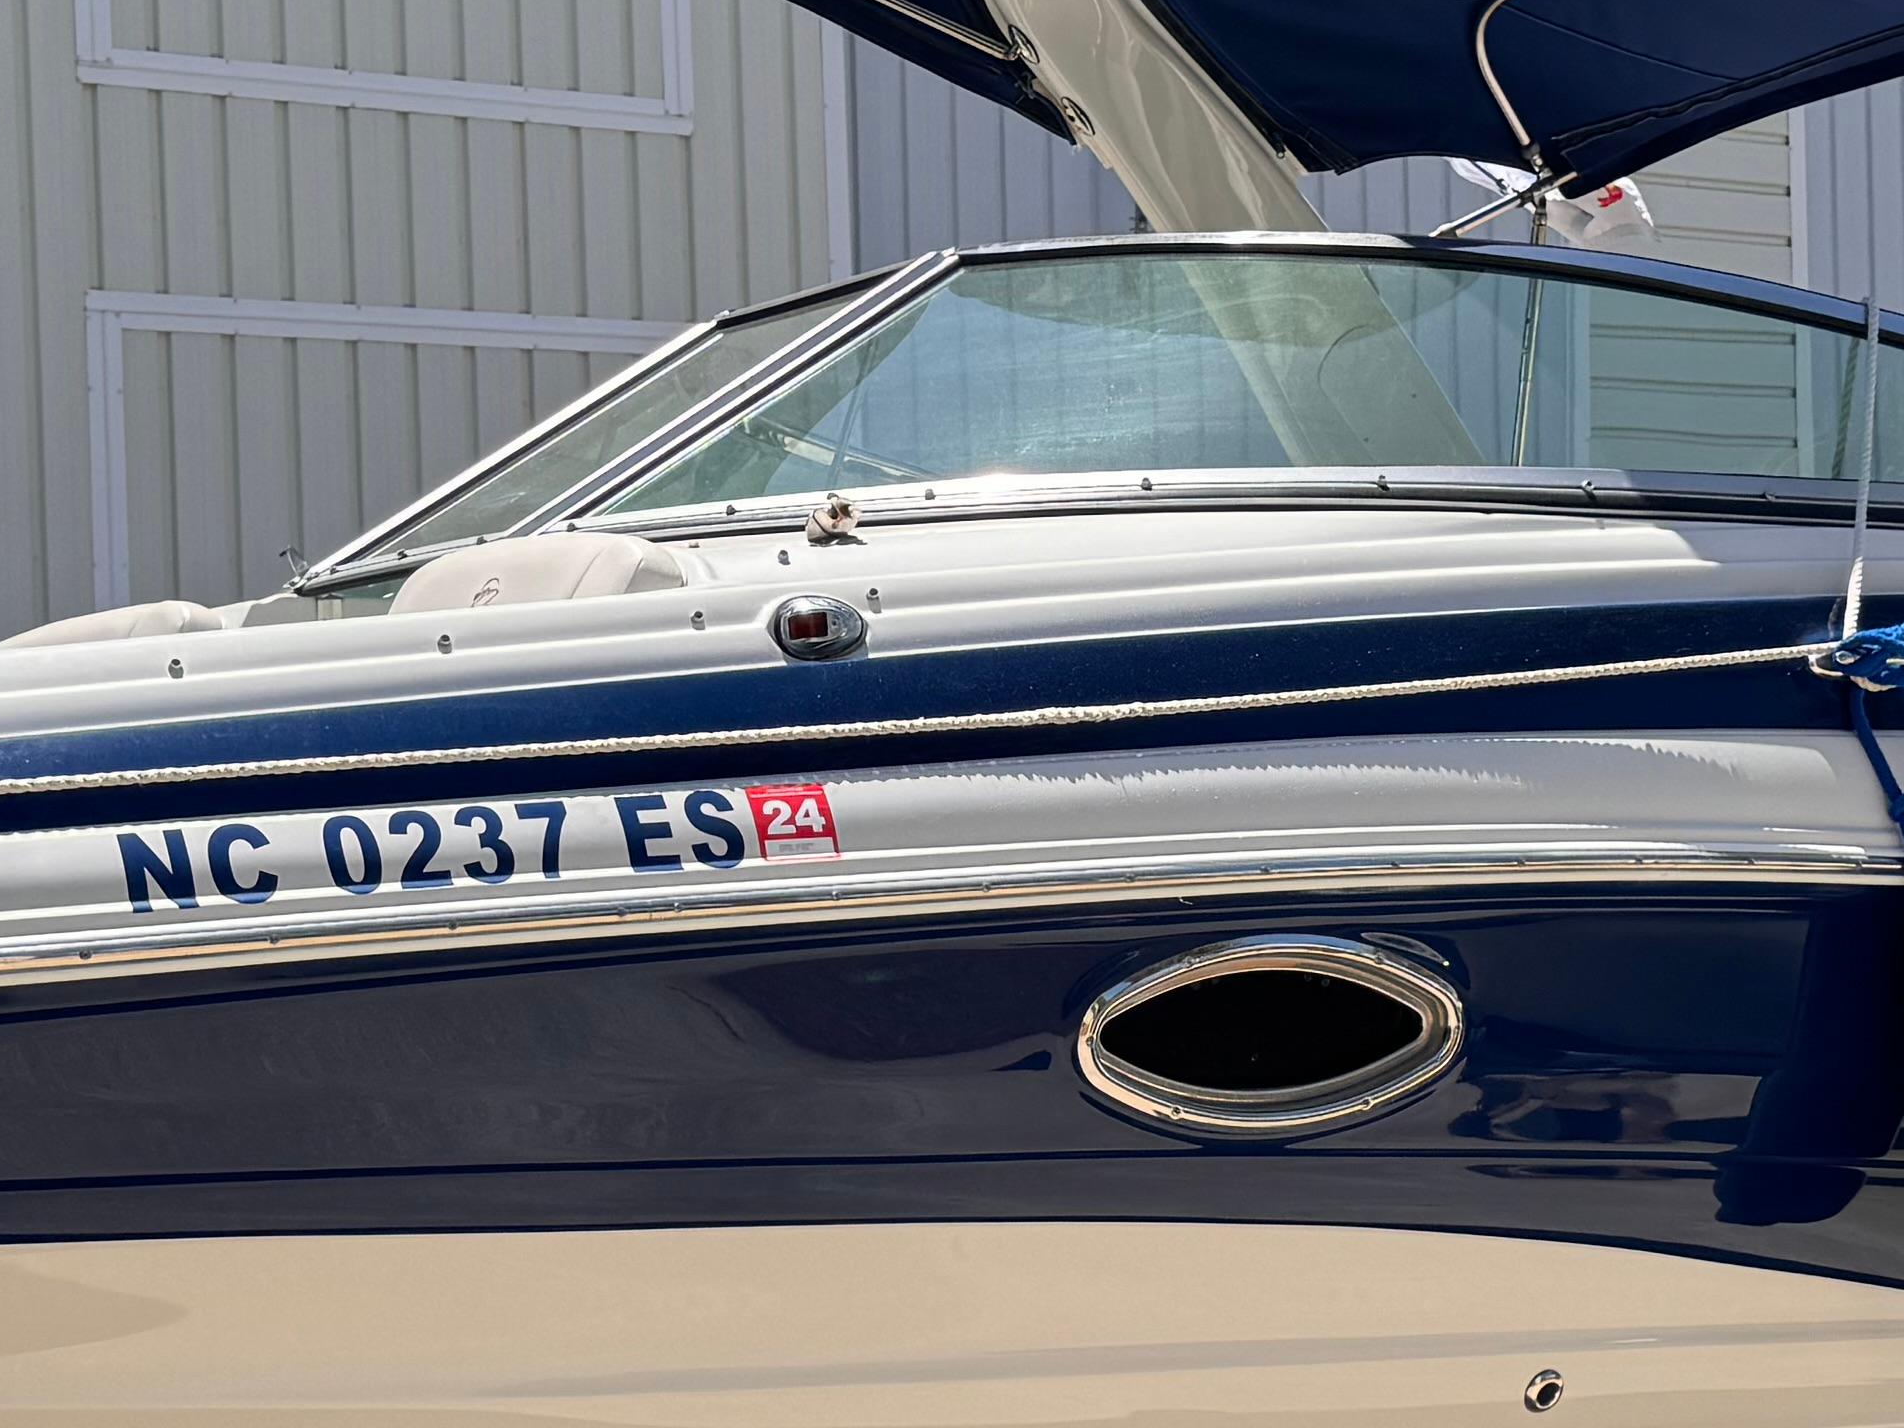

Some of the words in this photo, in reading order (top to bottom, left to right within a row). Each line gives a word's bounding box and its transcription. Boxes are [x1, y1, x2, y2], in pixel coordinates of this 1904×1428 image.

[117, 823, 279, 913] NC
[323, 801, 567, 895] 0237
[614, 789, 746, 873] ES
[762, 798, 826, 835] 24
